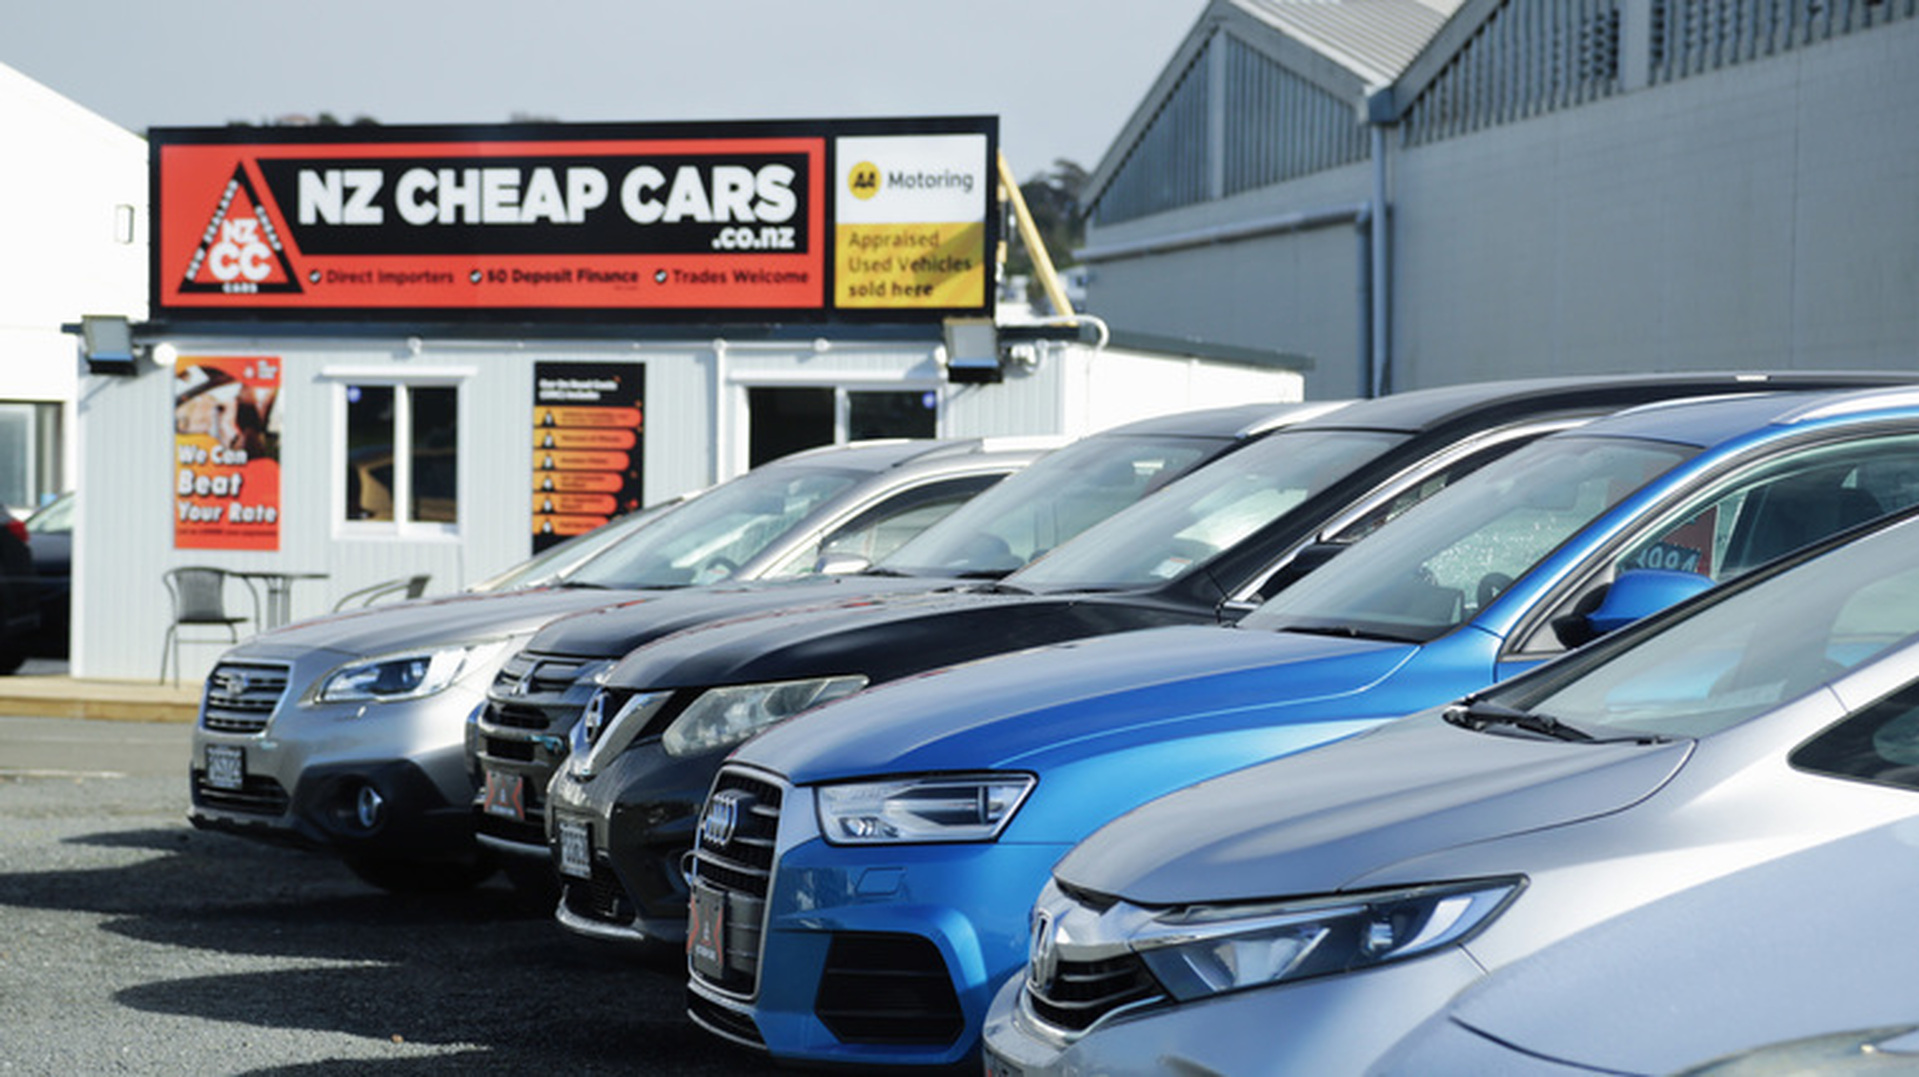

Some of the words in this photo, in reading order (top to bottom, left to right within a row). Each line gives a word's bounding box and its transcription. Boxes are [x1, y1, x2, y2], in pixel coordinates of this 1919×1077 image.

[852, 171, 877, 188] AA
[887, 169, 974, 194] Motoring
[298, 167, 384, 225] NZ
[395, 166, 609, 225] CHEAP
[620, 164, 798, 224] CARS
[222, 217, 259, 244] NZ
[711, 226, 795, 249] .co.nz
[848, 230, 940, 251] Appraised
[208, 240, 272, 281] CC
[848, 255, 893, 273] Used
[897, 254, 973, 273] Vehicles
[326, 269, 373, 284] Direct
[378, 269, 455, 286] Importers
[512, 269, 572, 286] Deposit
[577, 269, 639, 284] Finance
[673, 269, 727, 284] Trades
[733, 269, 809, 284] Welcome
[848, 281, 886, 297] sold
[891, 281, 934, 297] here
[178, 444, 207, 464] We
[210, 445, 248, 465] Can
[178, 468, 244, 497] Beat
[178, 501, 224, 523] Your
[228, 502, 278, 524] Rate
